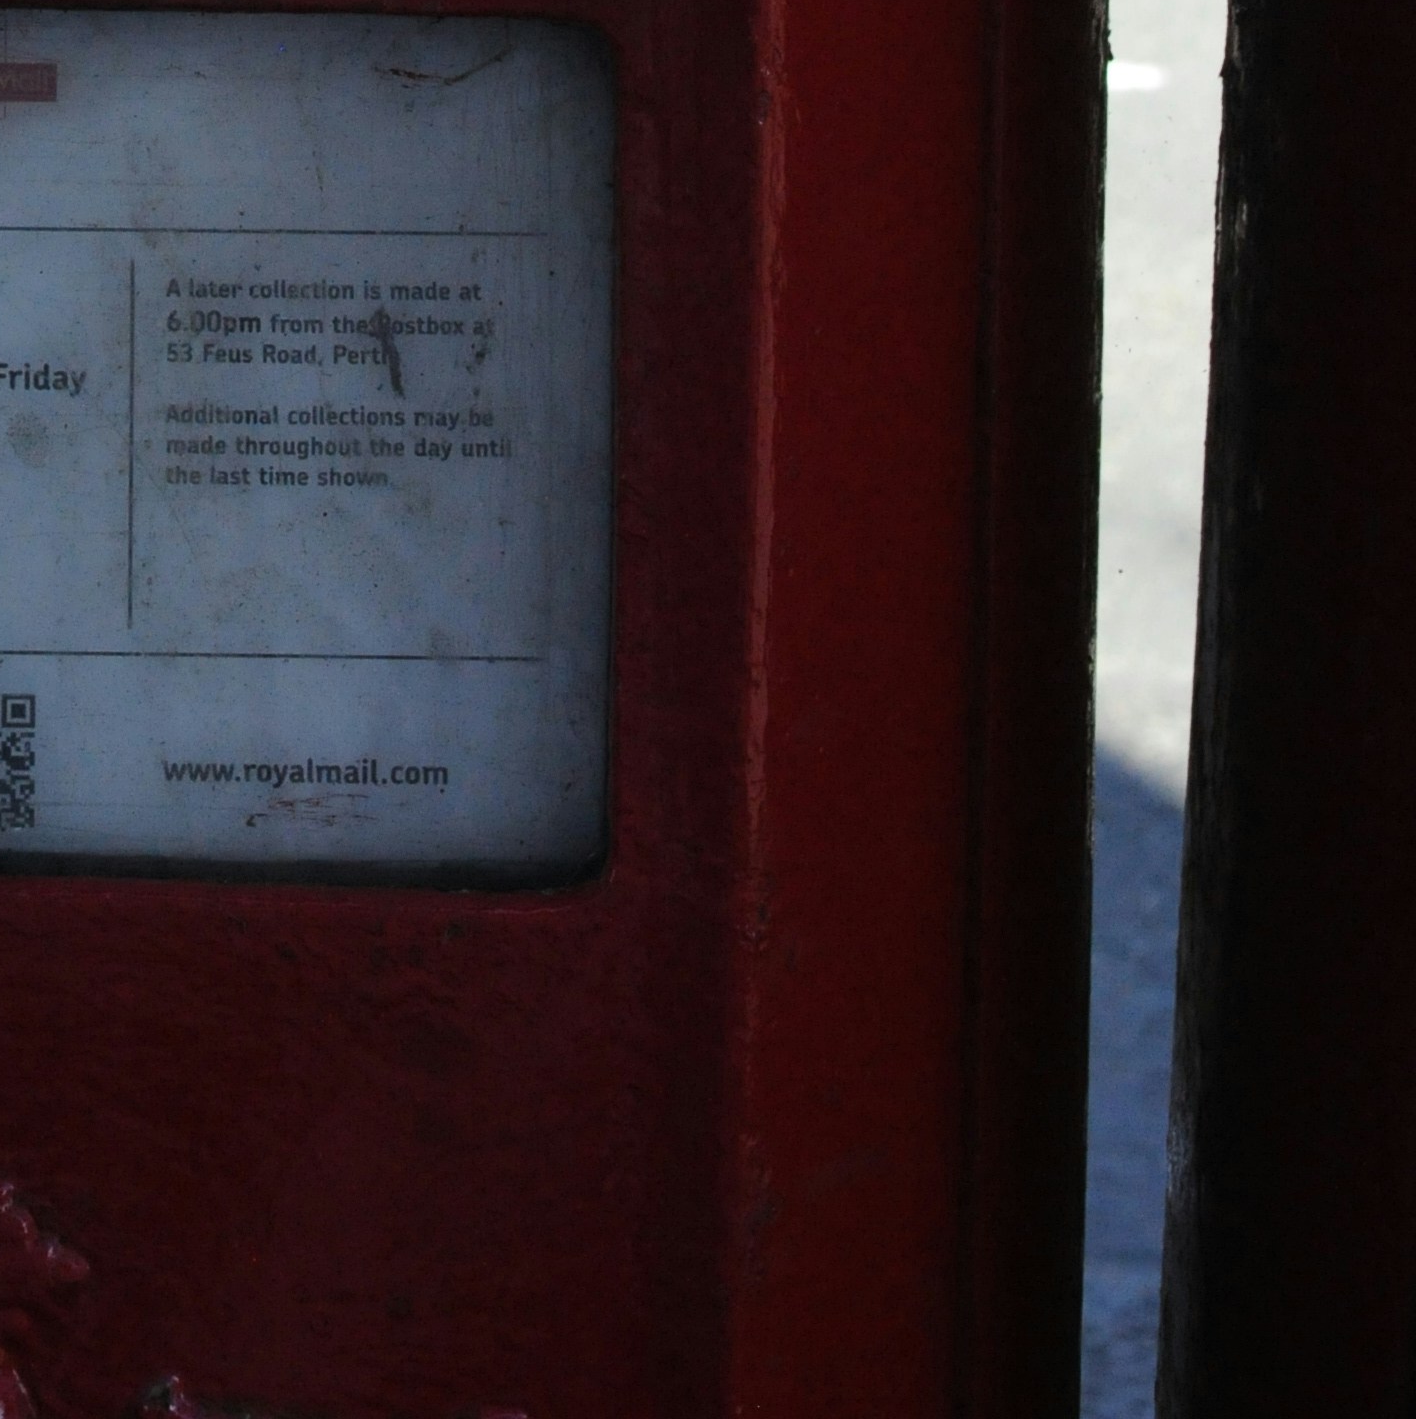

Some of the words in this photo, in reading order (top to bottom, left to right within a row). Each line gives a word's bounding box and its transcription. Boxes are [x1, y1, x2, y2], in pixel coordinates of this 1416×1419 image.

[166, 280, 181, 298] A
[190, 279, 241, 298] later
[249, 280, 354, 300] collection
[364, 281, 381, 300] is
[390, 281, 450, 301] made
[459, 284, 482, 301] at
[166, 311, 261, 336] 6.00pm
[270, 315, 323, 334] from
[332, 315, 370, 334] the
[473, 319, 493, 335] at
[167, 344, 193, 363] 53
[203, 345, 253, 364] Feus
[263, 345, 322, 366] Road,
[165, 405, 279, 426] Additional
[288, 406, 405, 426] collections
[414, 411, 460, 429] may
[469, 408, 493, 427] be
[166, 436, 226, 455] made
[235, 436, 360, 460] throughout
[369, 438, 405, 458] the
[414, 439, 454, 461] day
[462, 439, 512, 458] until
[166, 466, 201, 485] the
[210, 467, 250, 485] last
[259, 467, 308, 486] time
[164, 758, 448, 788] www.royalmail.com
